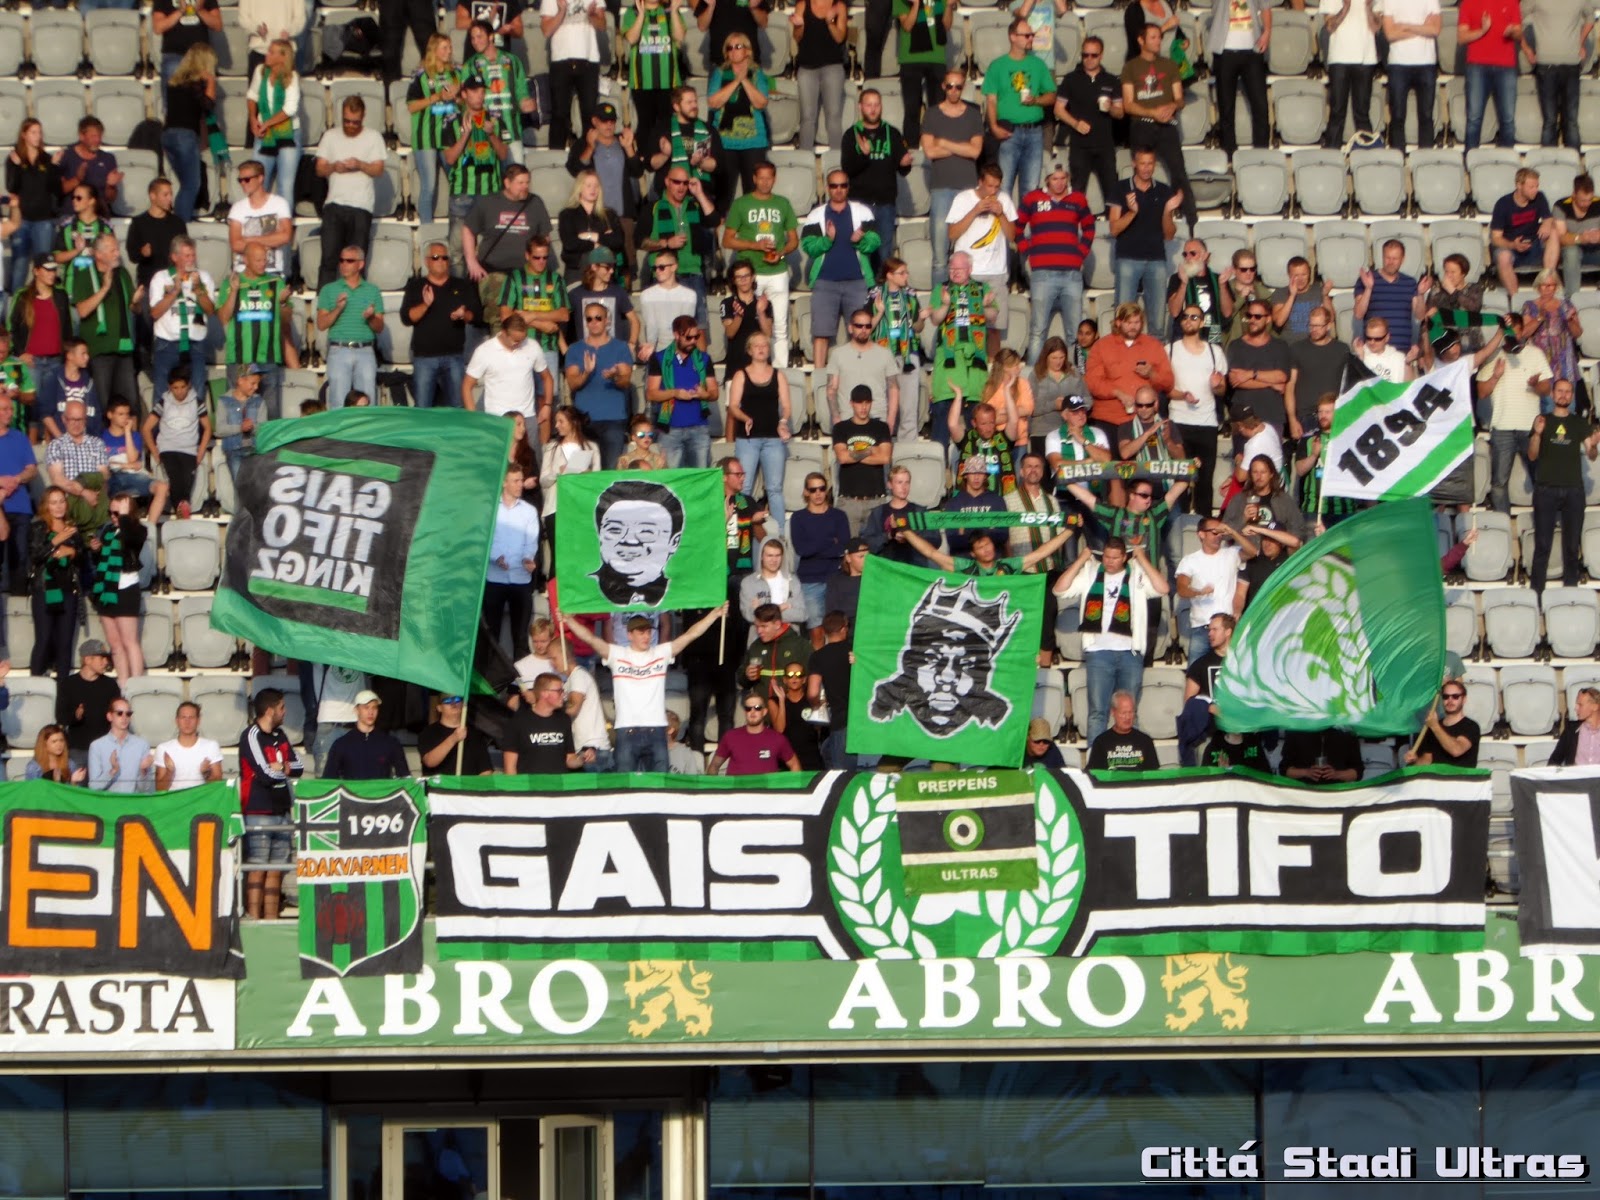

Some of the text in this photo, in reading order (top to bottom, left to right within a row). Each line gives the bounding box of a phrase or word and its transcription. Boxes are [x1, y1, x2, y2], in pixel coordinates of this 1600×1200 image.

[748, 207, 781, 223] GAIS
[239, 300, 273, 311] ABRO
[1337, 383, 1454, 487] 1894
[1062, 460, 1190, 479] GAIS GAIS
[1020, 512, 1062, 525] 1894
[618, 665, 652, 677] adidas
[918, 777, 997, 793] PREPPENS
[348, 813, 404, 836] 1996
[447, 819, 812, 910] GAIS
[1104, 807, 1453, 899] TIFO
[4, 810, 222, 950] EN
[942, 868, 998, 881] ULTRAS
[286, 959, 608, 1036] ABRO
[828, 956, 1146, 1029] ABRO
[1363, 950, 1600, 1024] ABR
[0, 980, 214, 1034] RASTA
